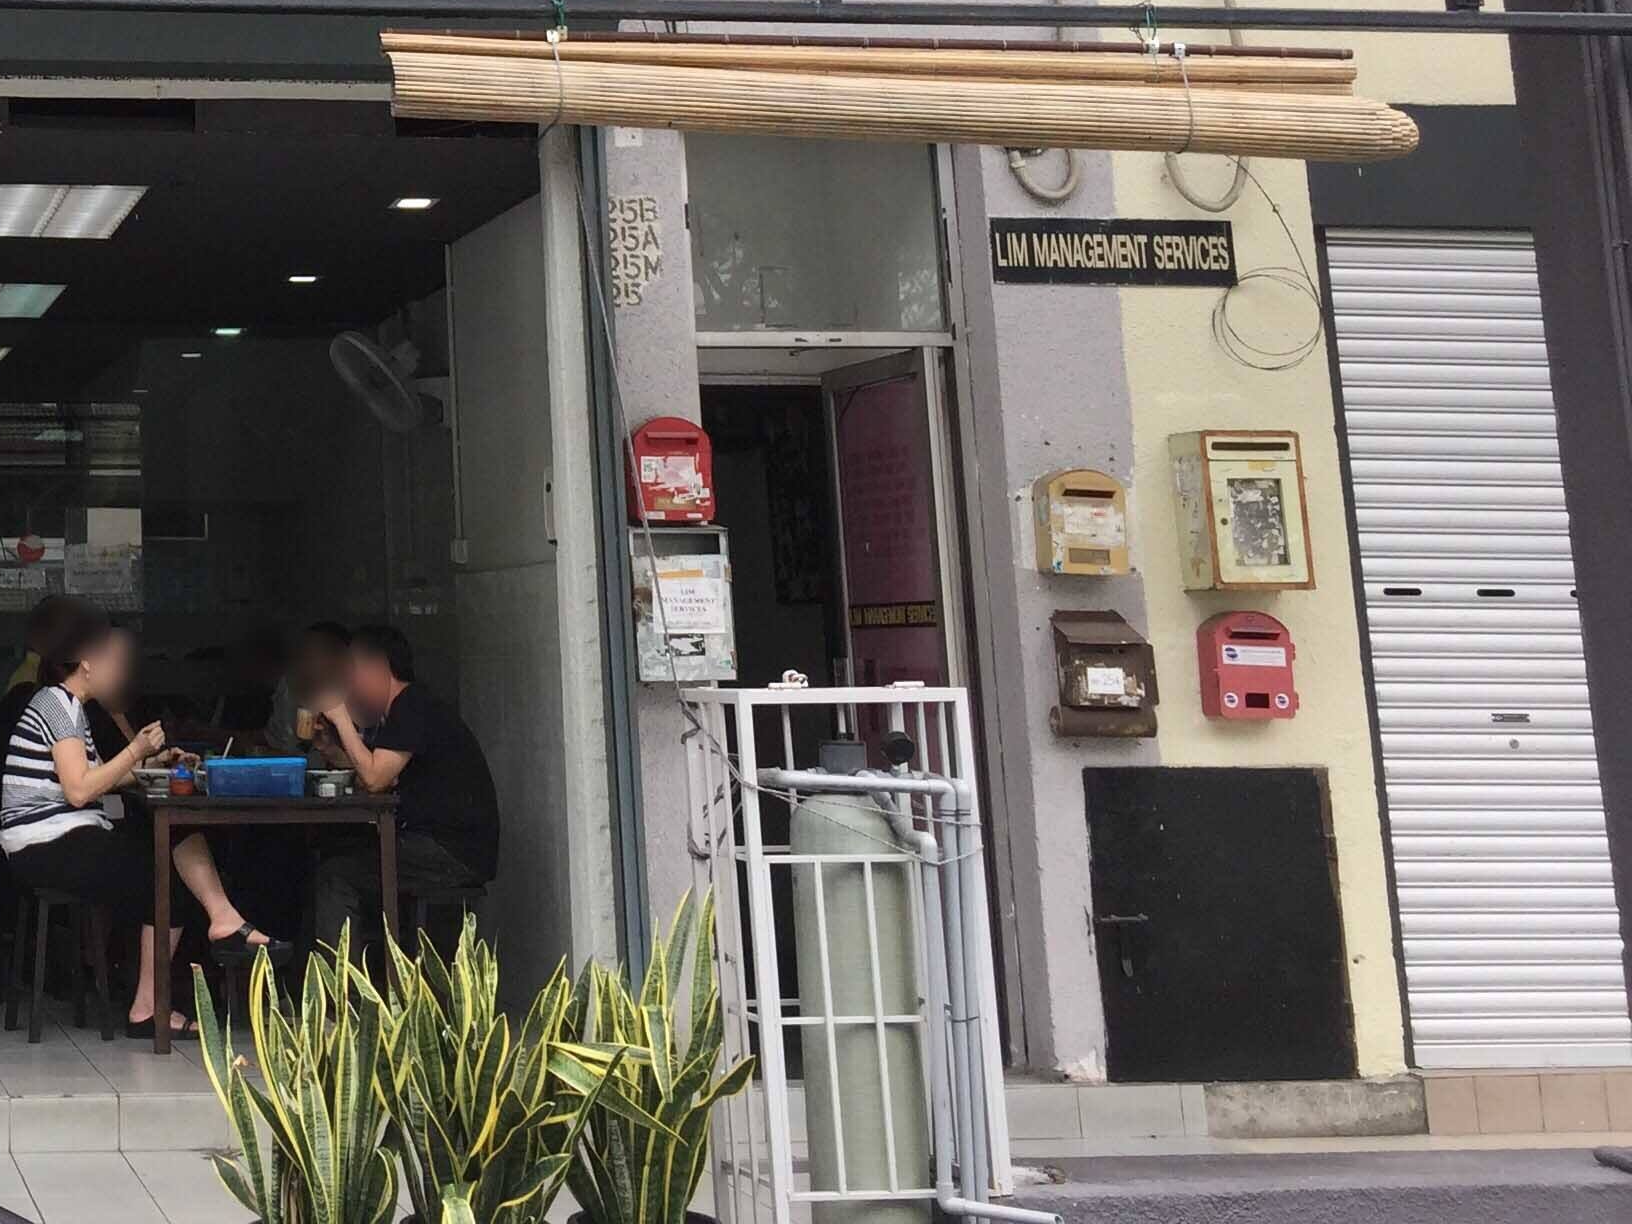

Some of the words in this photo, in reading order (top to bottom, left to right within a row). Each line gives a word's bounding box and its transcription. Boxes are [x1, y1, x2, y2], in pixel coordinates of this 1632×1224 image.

[995, 232, 1029, 267] LIM
[1032, 233, 1148, 269] MANAGEMENT
[1153, 235, 1229, 271] SERVICES
